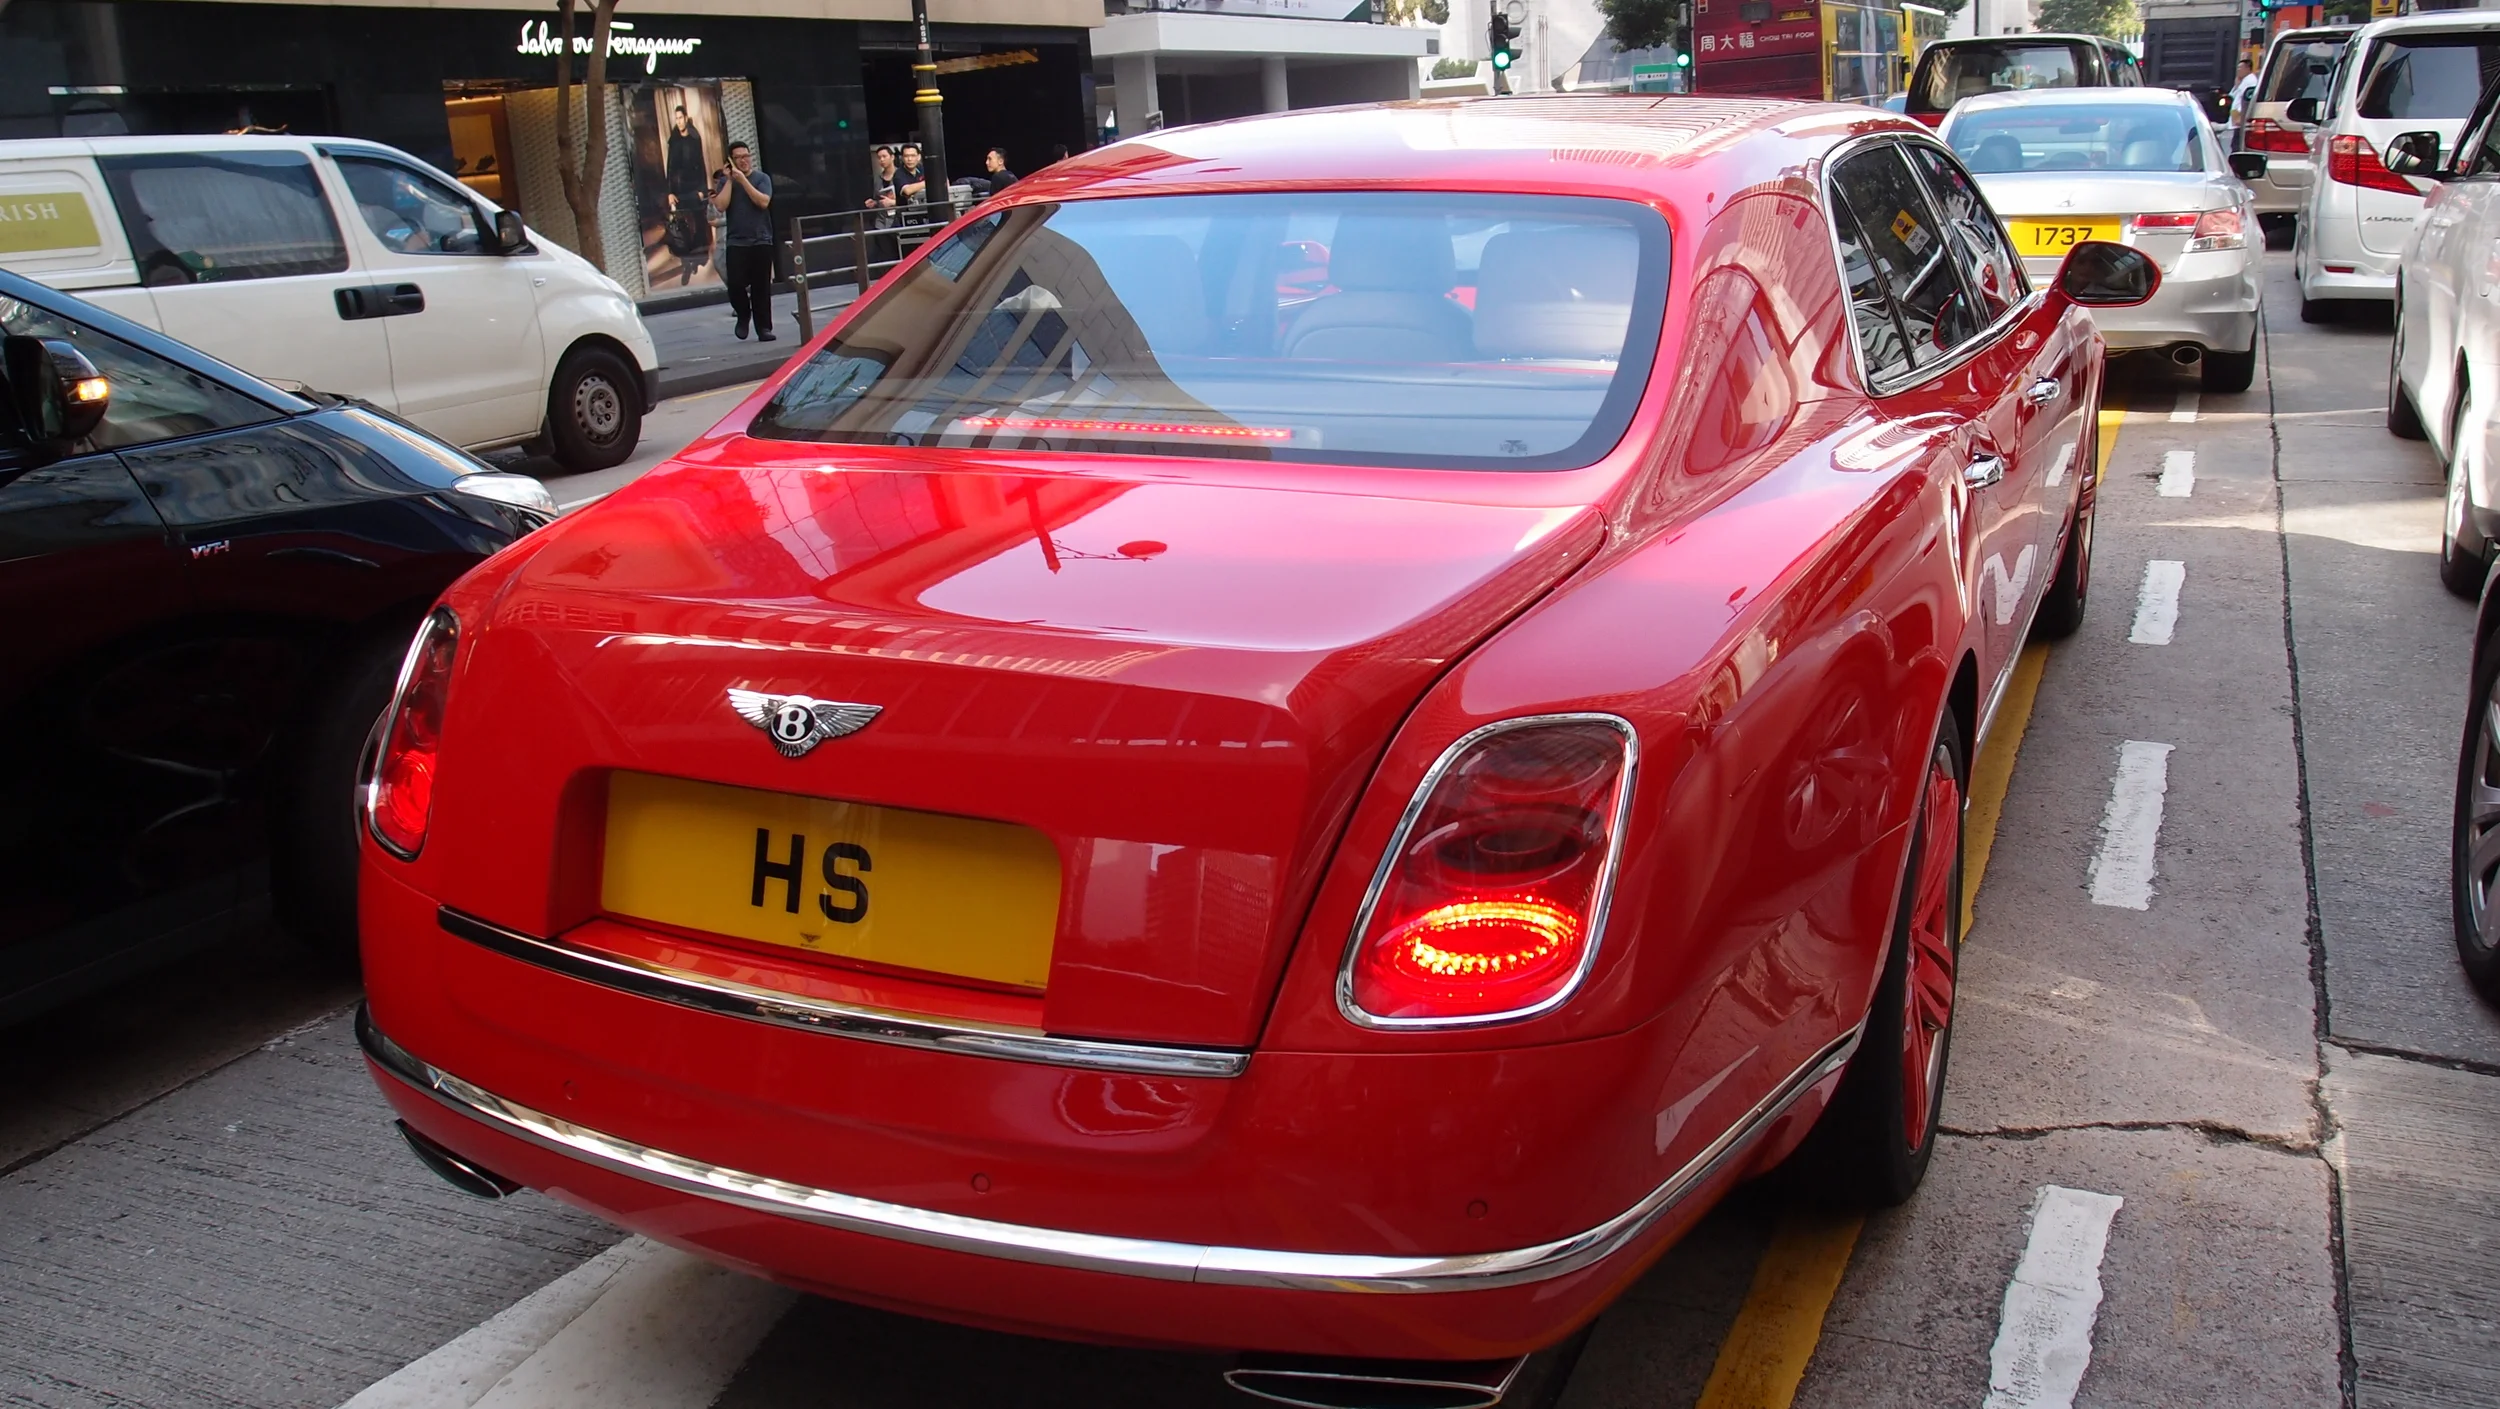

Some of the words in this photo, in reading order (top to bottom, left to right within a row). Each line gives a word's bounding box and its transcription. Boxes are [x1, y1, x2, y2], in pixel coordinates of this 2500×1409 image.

[606, 21, 702, 75] Ferragamo
[1700, 32, 1755, 52] 周大福
[1795, 31, 1815, 39] FOOK
[2035, 227, 2093, 246] 1737
[777, 709, 808, 741] B
[751, 827, 872, 924] HS
